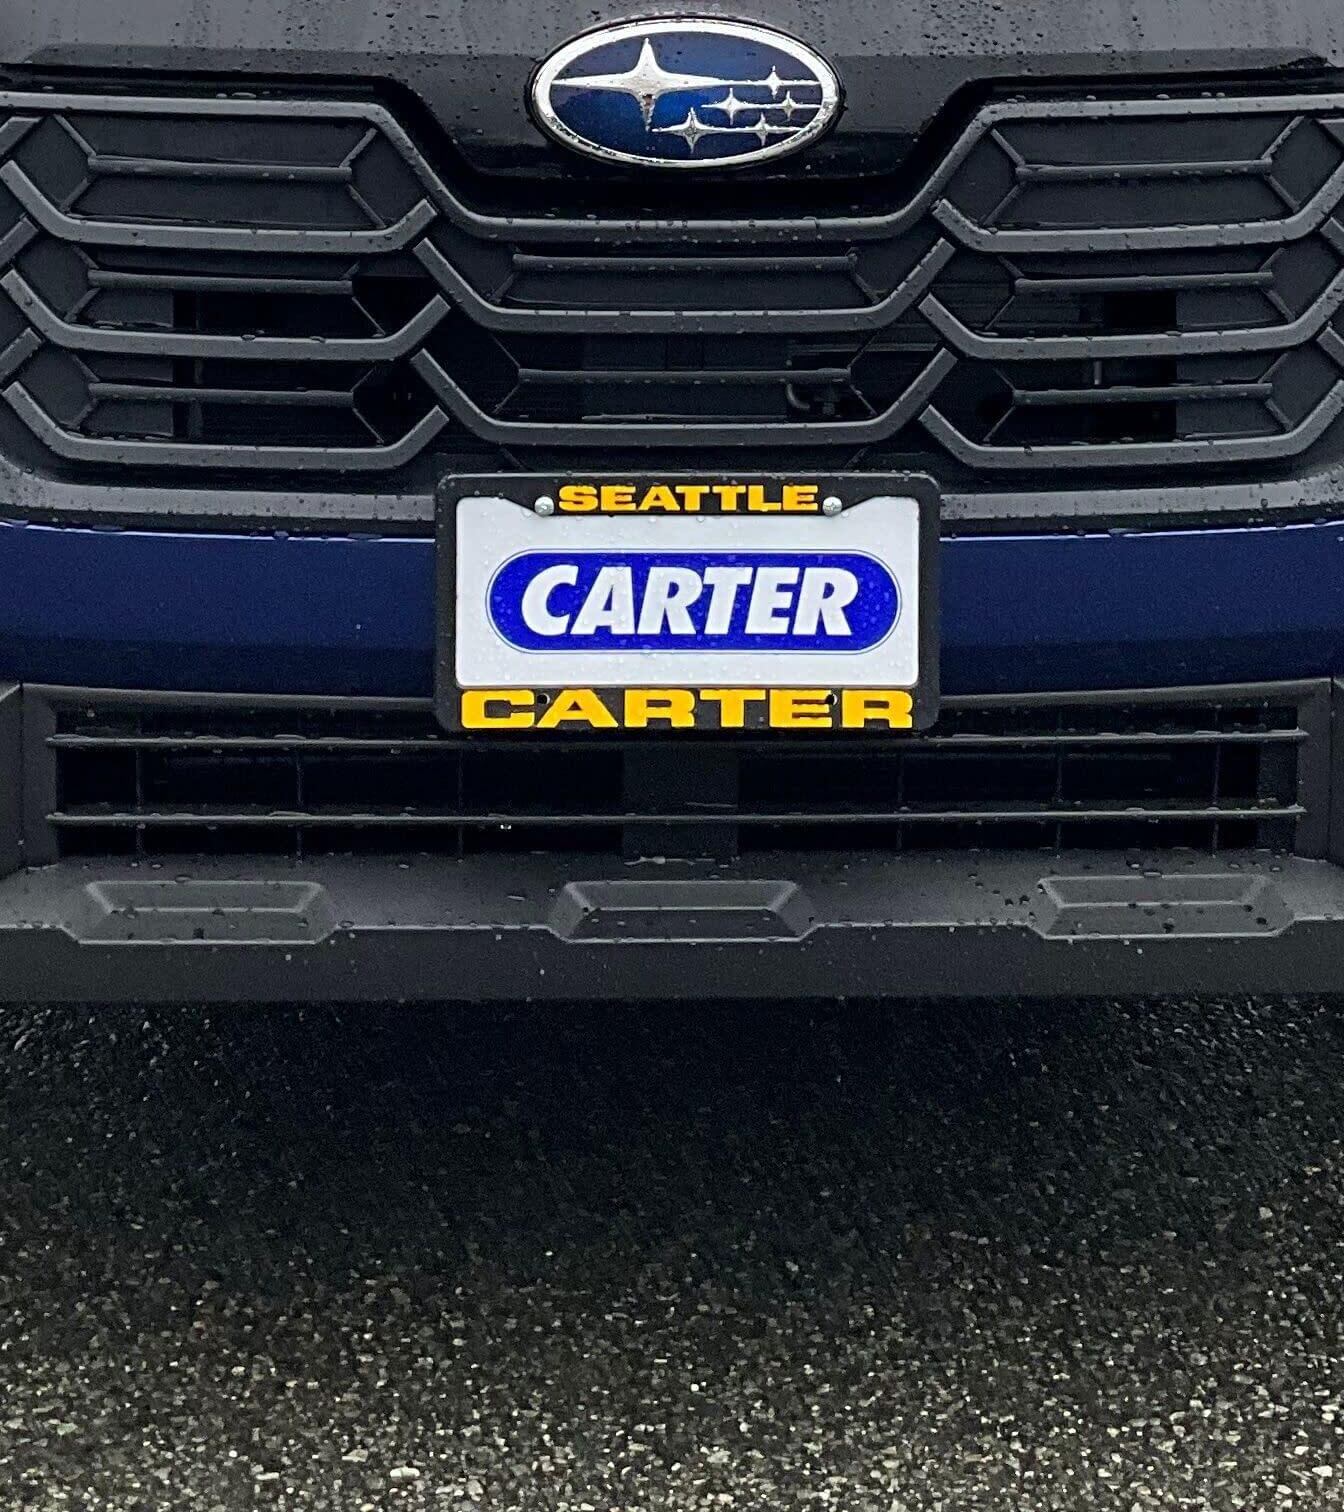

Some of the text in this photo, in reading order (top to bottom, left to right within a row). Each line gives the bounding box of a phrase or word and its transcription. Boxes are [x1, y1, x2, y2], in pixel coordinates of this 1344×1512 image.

[558, 484, 819, 512] SEATTLE
[520, 564, 859, 637] CARTER
[461, 689, 914, 730] CARTER
